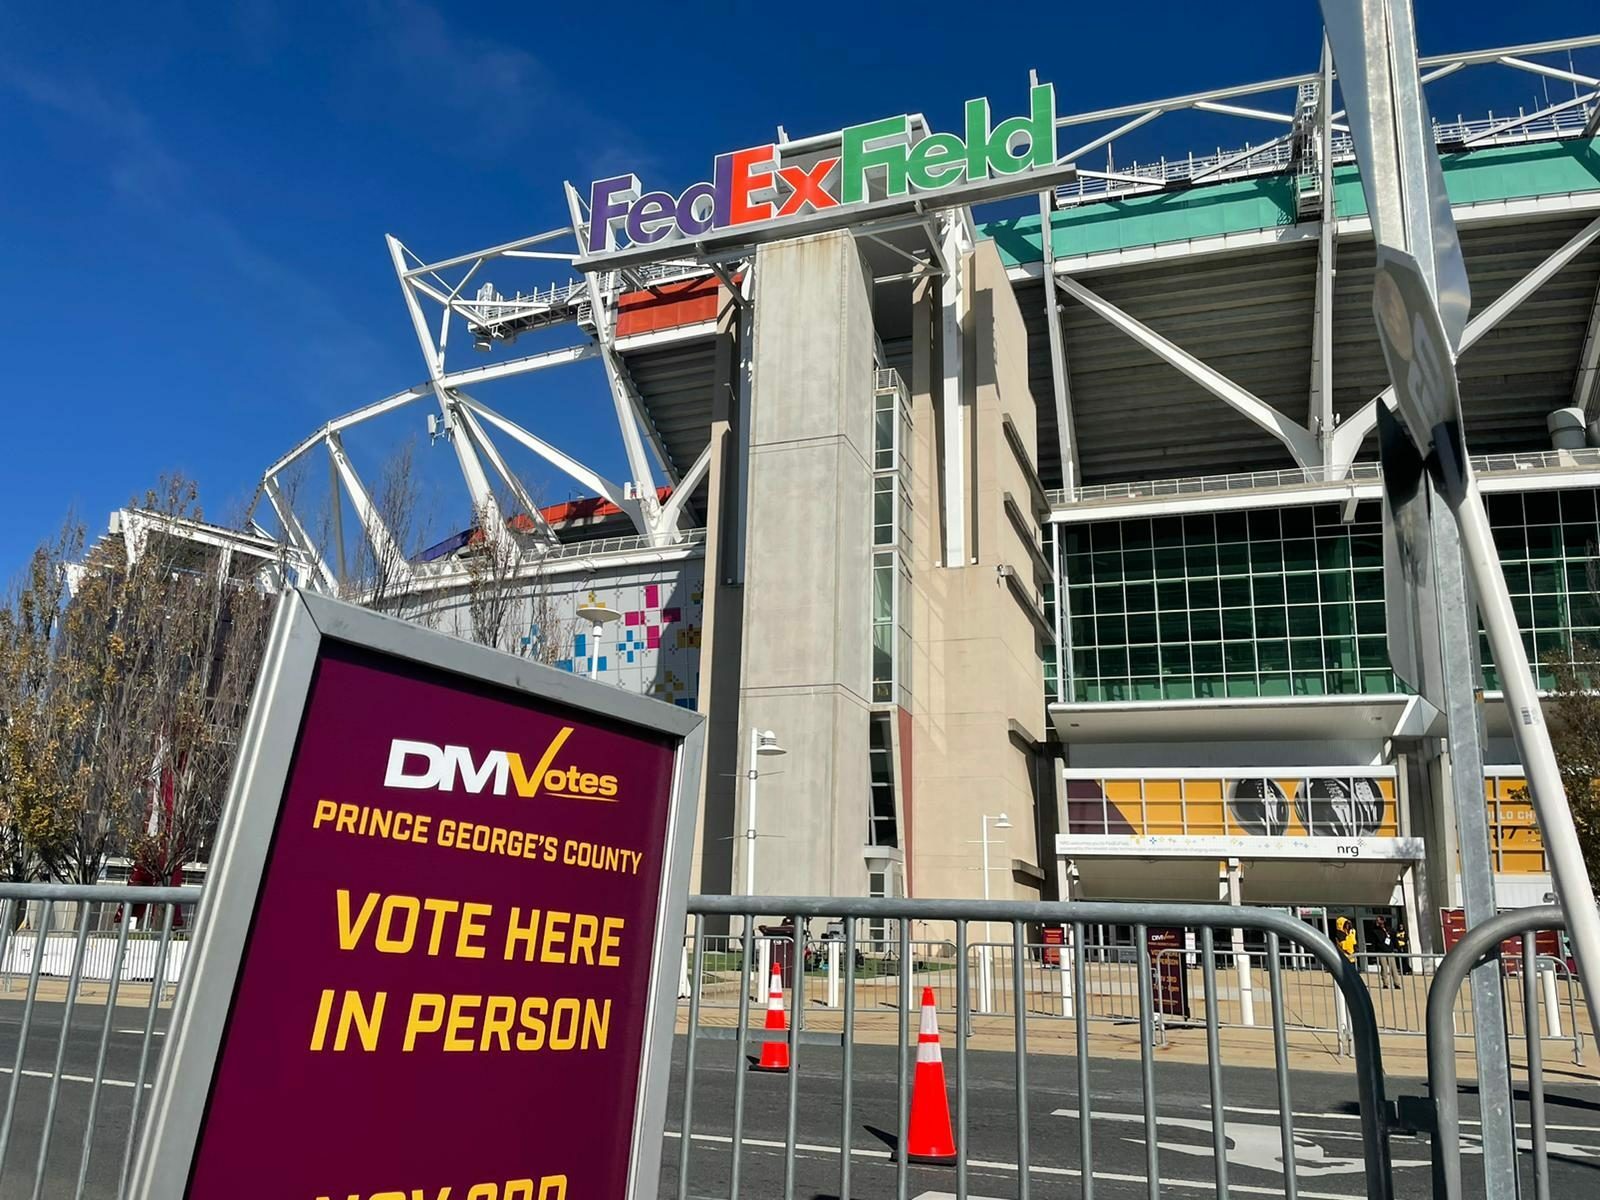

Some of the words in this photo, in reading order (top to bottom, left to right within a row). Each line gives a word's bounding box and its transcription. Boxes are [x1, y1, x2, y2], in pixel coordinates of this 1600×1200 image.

[313, 800, 431, 844] PRINCE
[438, 820, 557, 862] GEORGE'S
[563, 839, 643, 875] COUNTY
[1337, 845, 1359, 857] nrg
[336, 889, 493, 959] VOTE
[504, 907, 625, 967] HERE
[310, 989, 387, 1052] IN
[402, 993, 612, 1052] PERSON
